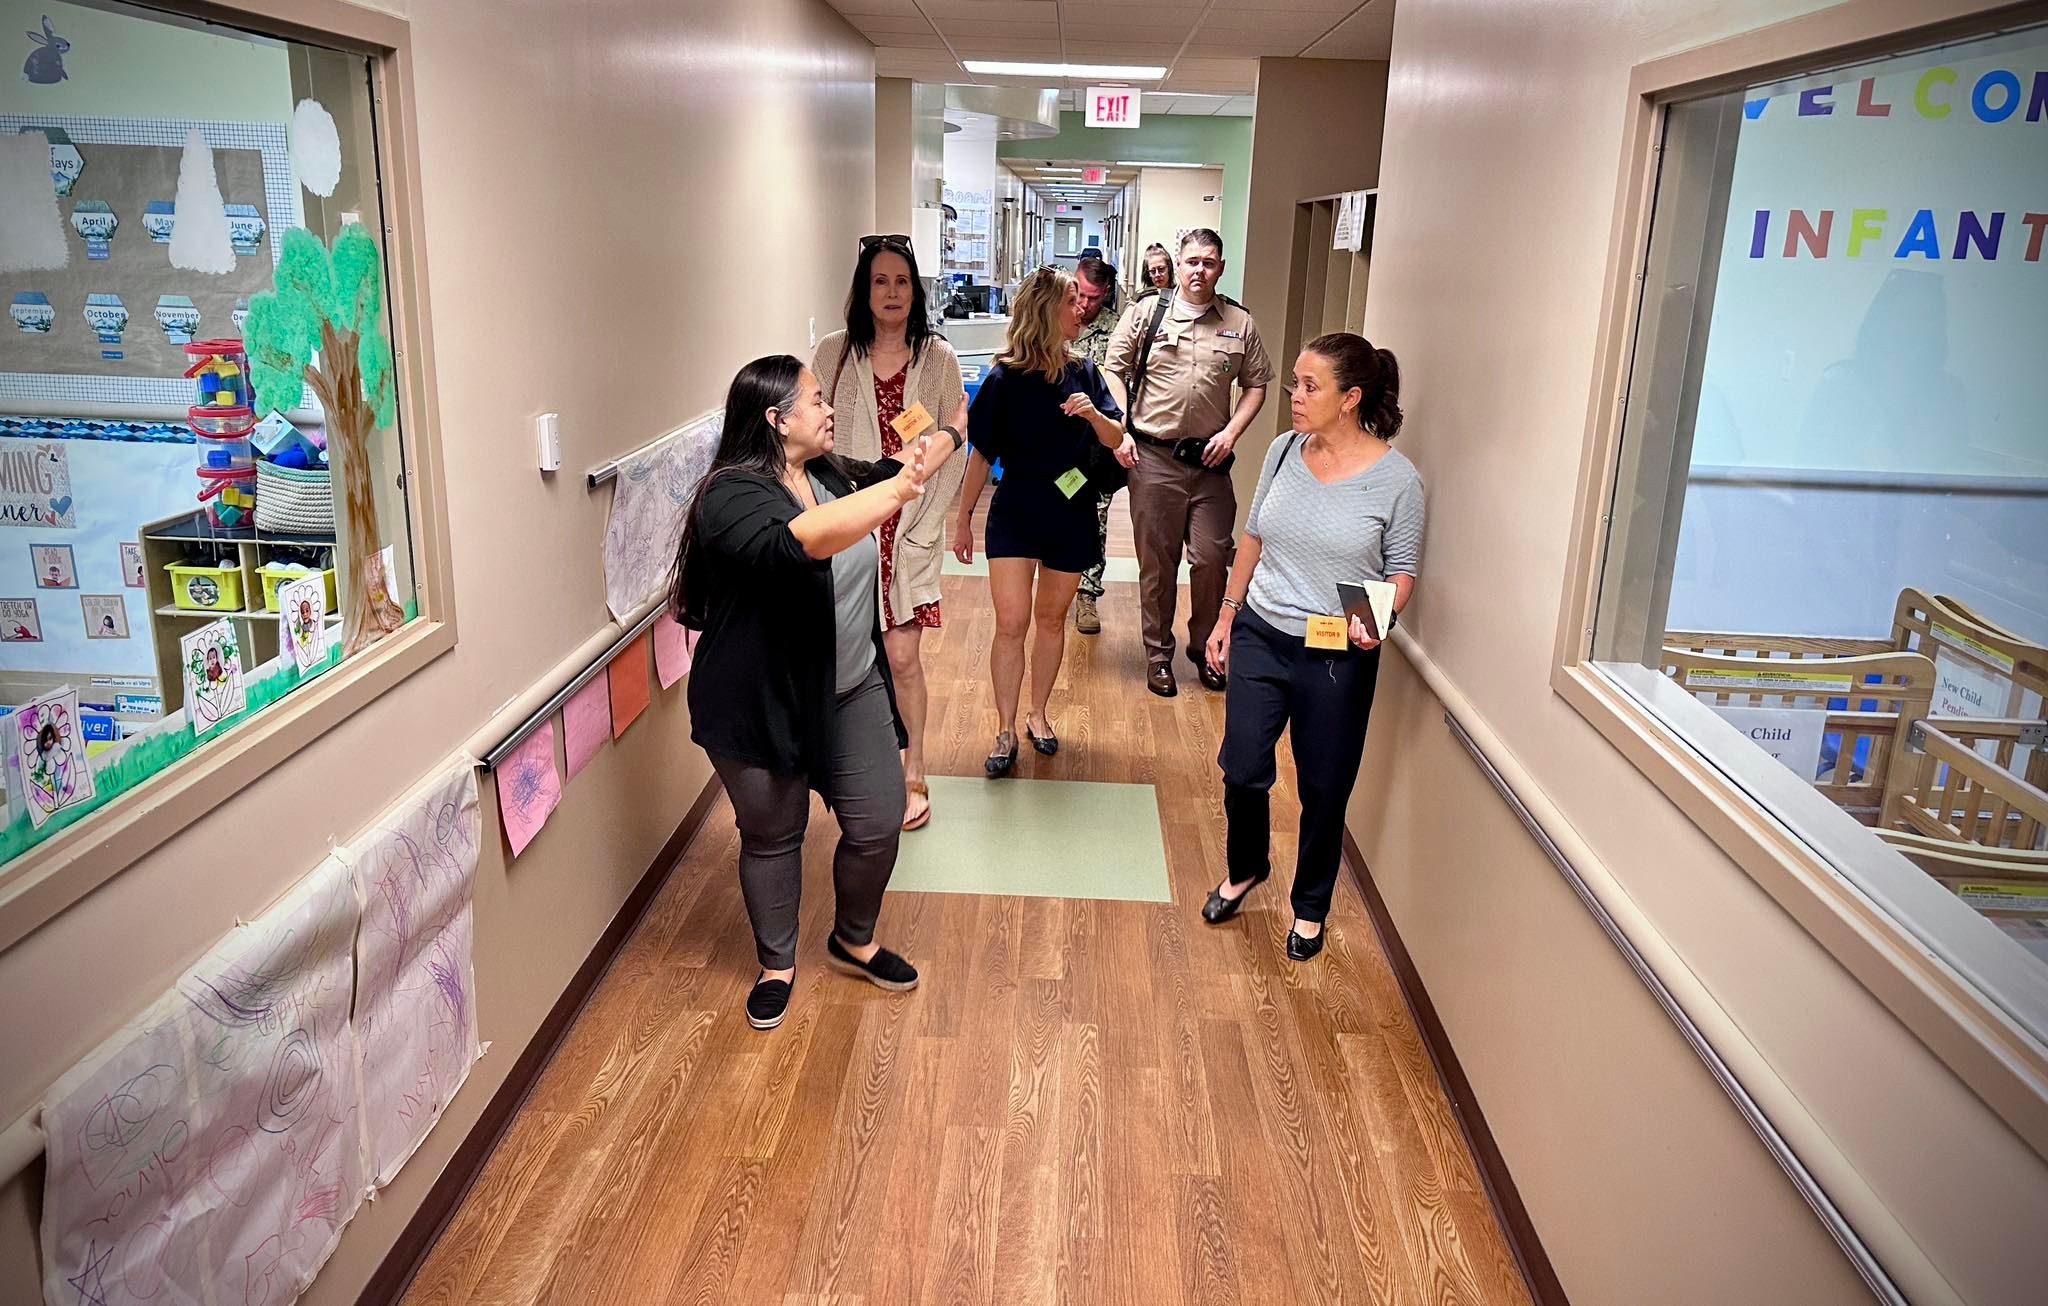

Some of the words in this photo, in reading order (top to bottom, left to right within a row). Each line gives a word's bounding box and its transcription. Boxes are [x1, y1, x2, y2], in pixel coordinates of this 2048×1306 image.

[1096, 96, 1129, 123] EXIT
[82, 217, 106, 226] April
[230, 221, 253, 230] June
[87, 309, 126, 319] October
[156, 310, 199, 319] November
[1316, 630, 1336, 638] VISITOR
[1941, 676, 1959, 694] New
[1960, 686, 1982, 707] Child
[1750, 727, 1792, 741] Child
